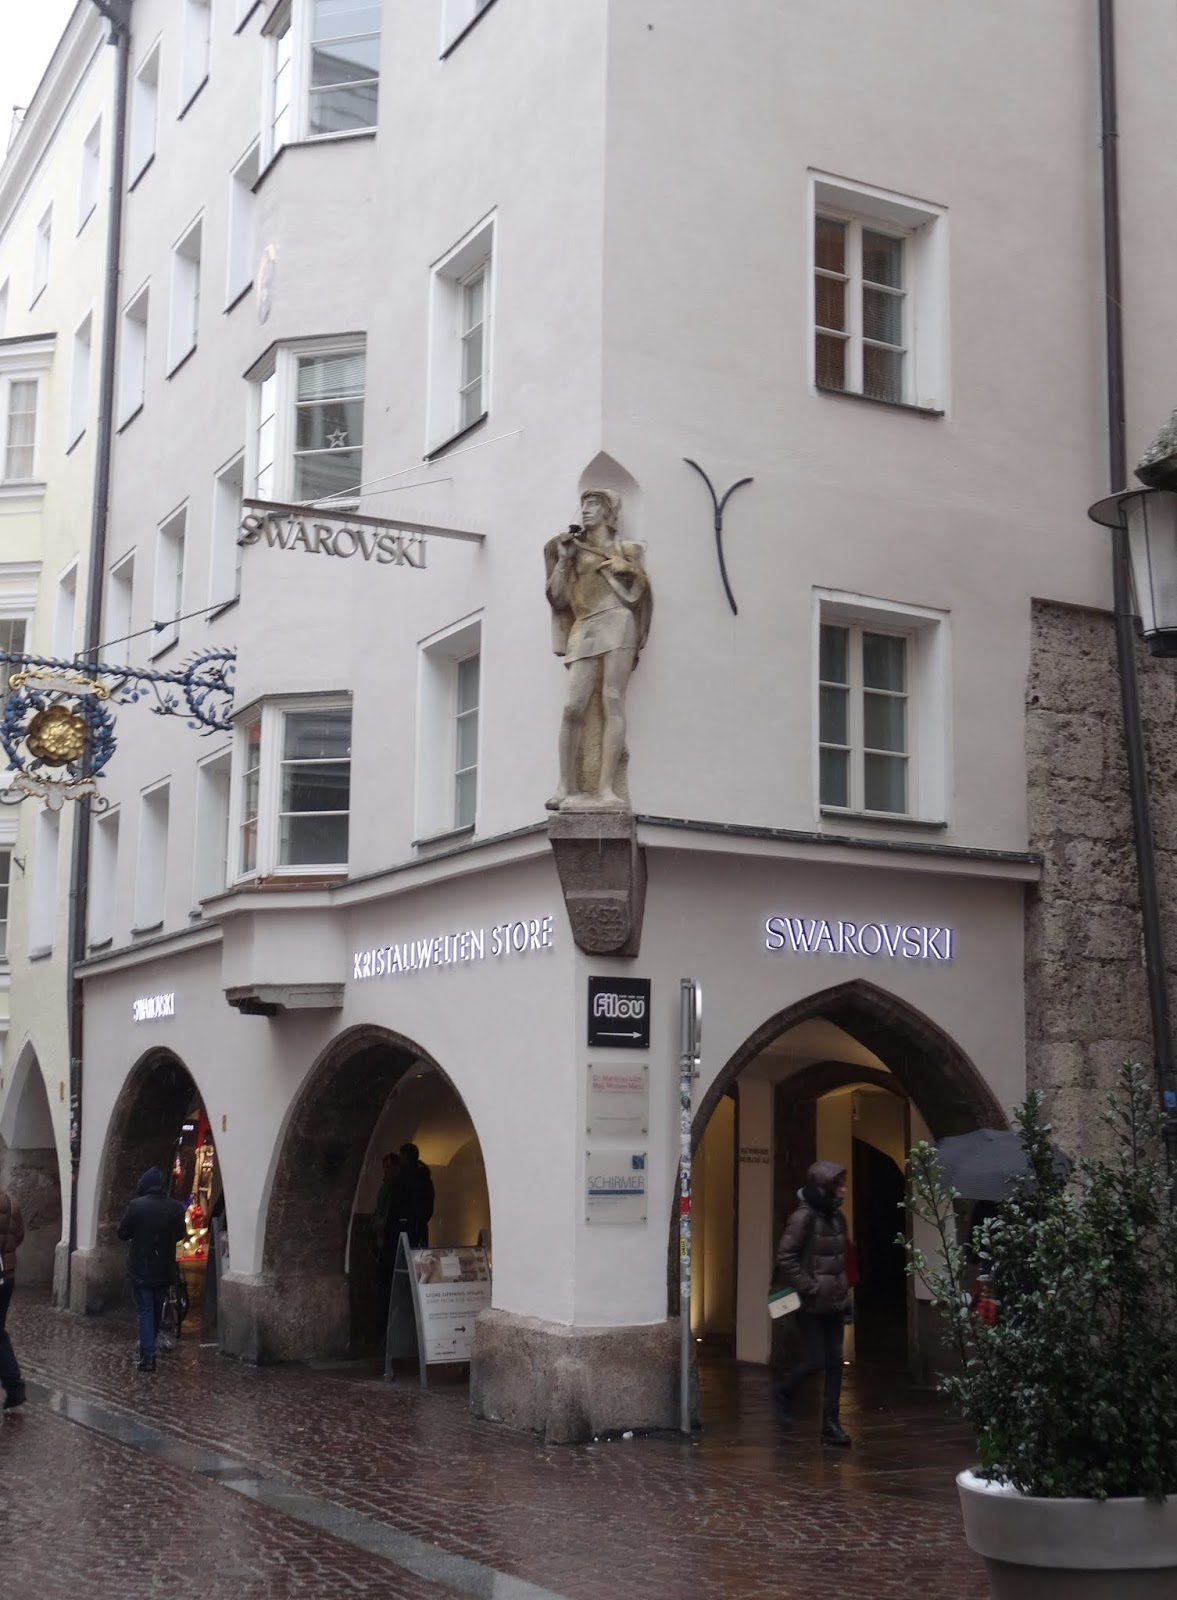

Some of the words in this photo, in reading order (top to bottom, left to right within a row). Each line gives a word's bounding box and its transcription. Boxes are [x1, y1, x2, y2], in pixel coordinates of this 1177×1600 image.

[239, 513, 428, 570] SWAROVSKI
[353, 928, 485, 980] KRISTALLWELTEN
[491, 915, 554, 956] STORE
[764, 916, 955, 960] SWAROVSKI
[593, 992, 646, 1019] Filou
[587, 1175, 645, 1190] SCHIRMER
